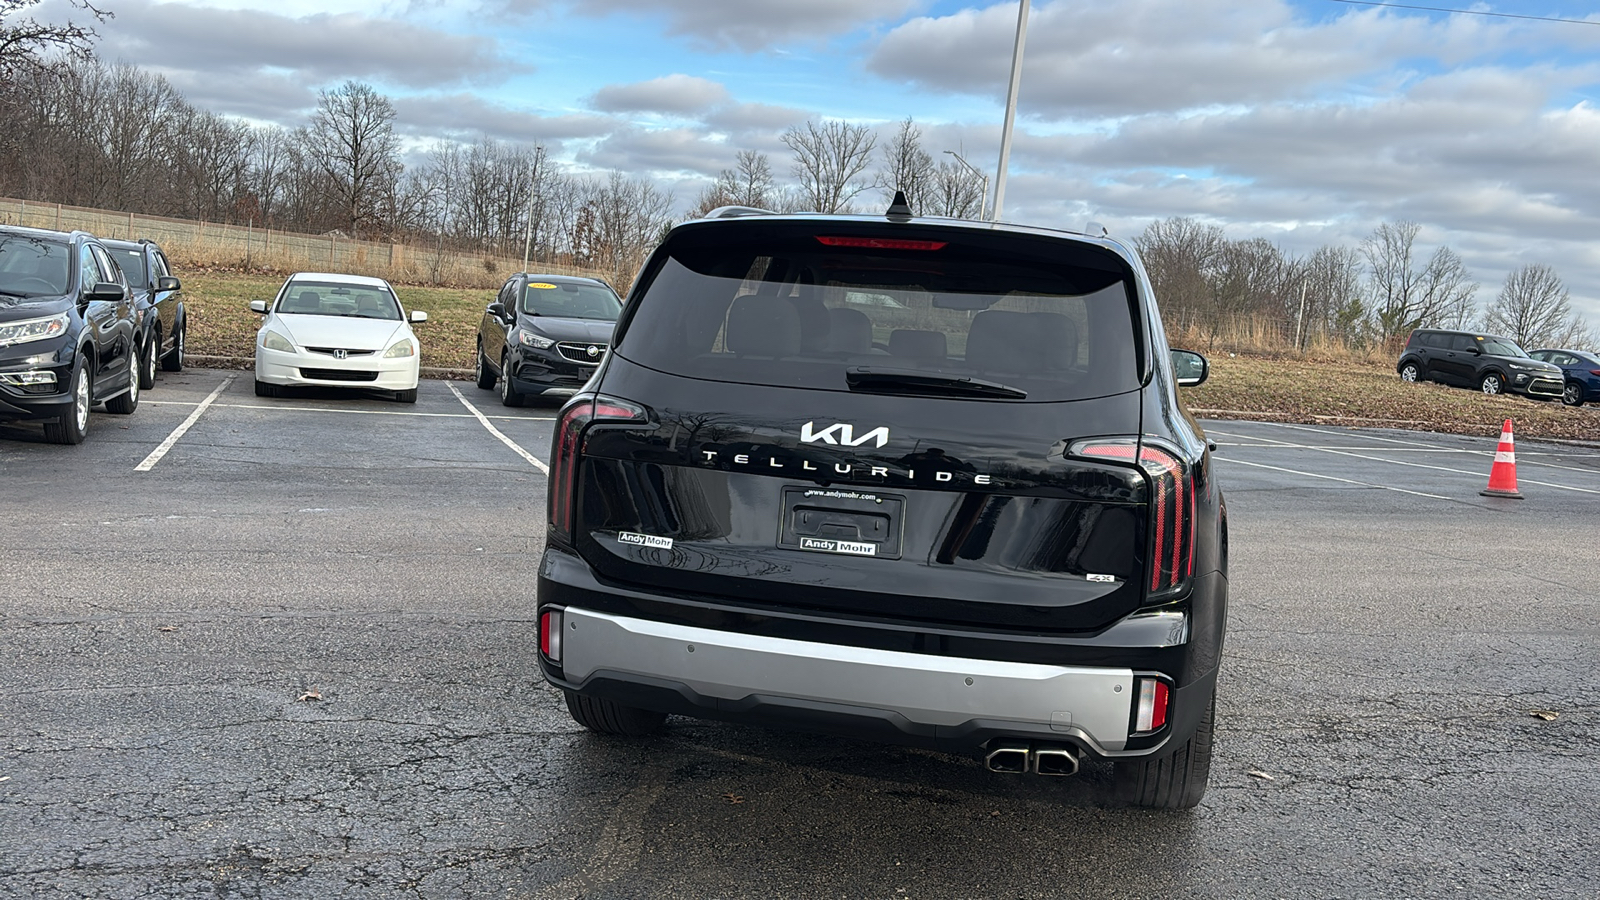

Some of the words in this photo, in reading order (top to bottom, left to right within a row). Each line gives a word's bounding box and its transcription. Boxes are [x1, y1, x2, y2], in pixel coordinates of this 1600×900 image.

[801, 421, 889, 448] KIA
[702, 450, 991, 485] TELLURIDE
[808, 489, 876, 500] www.andymohr.com
[621, 532, 645, 544] Andy
[646, 536, 671, 547] Mohr
[804, 539, 835, 550] Andy
[840, 543, 873, 553] Mohr
